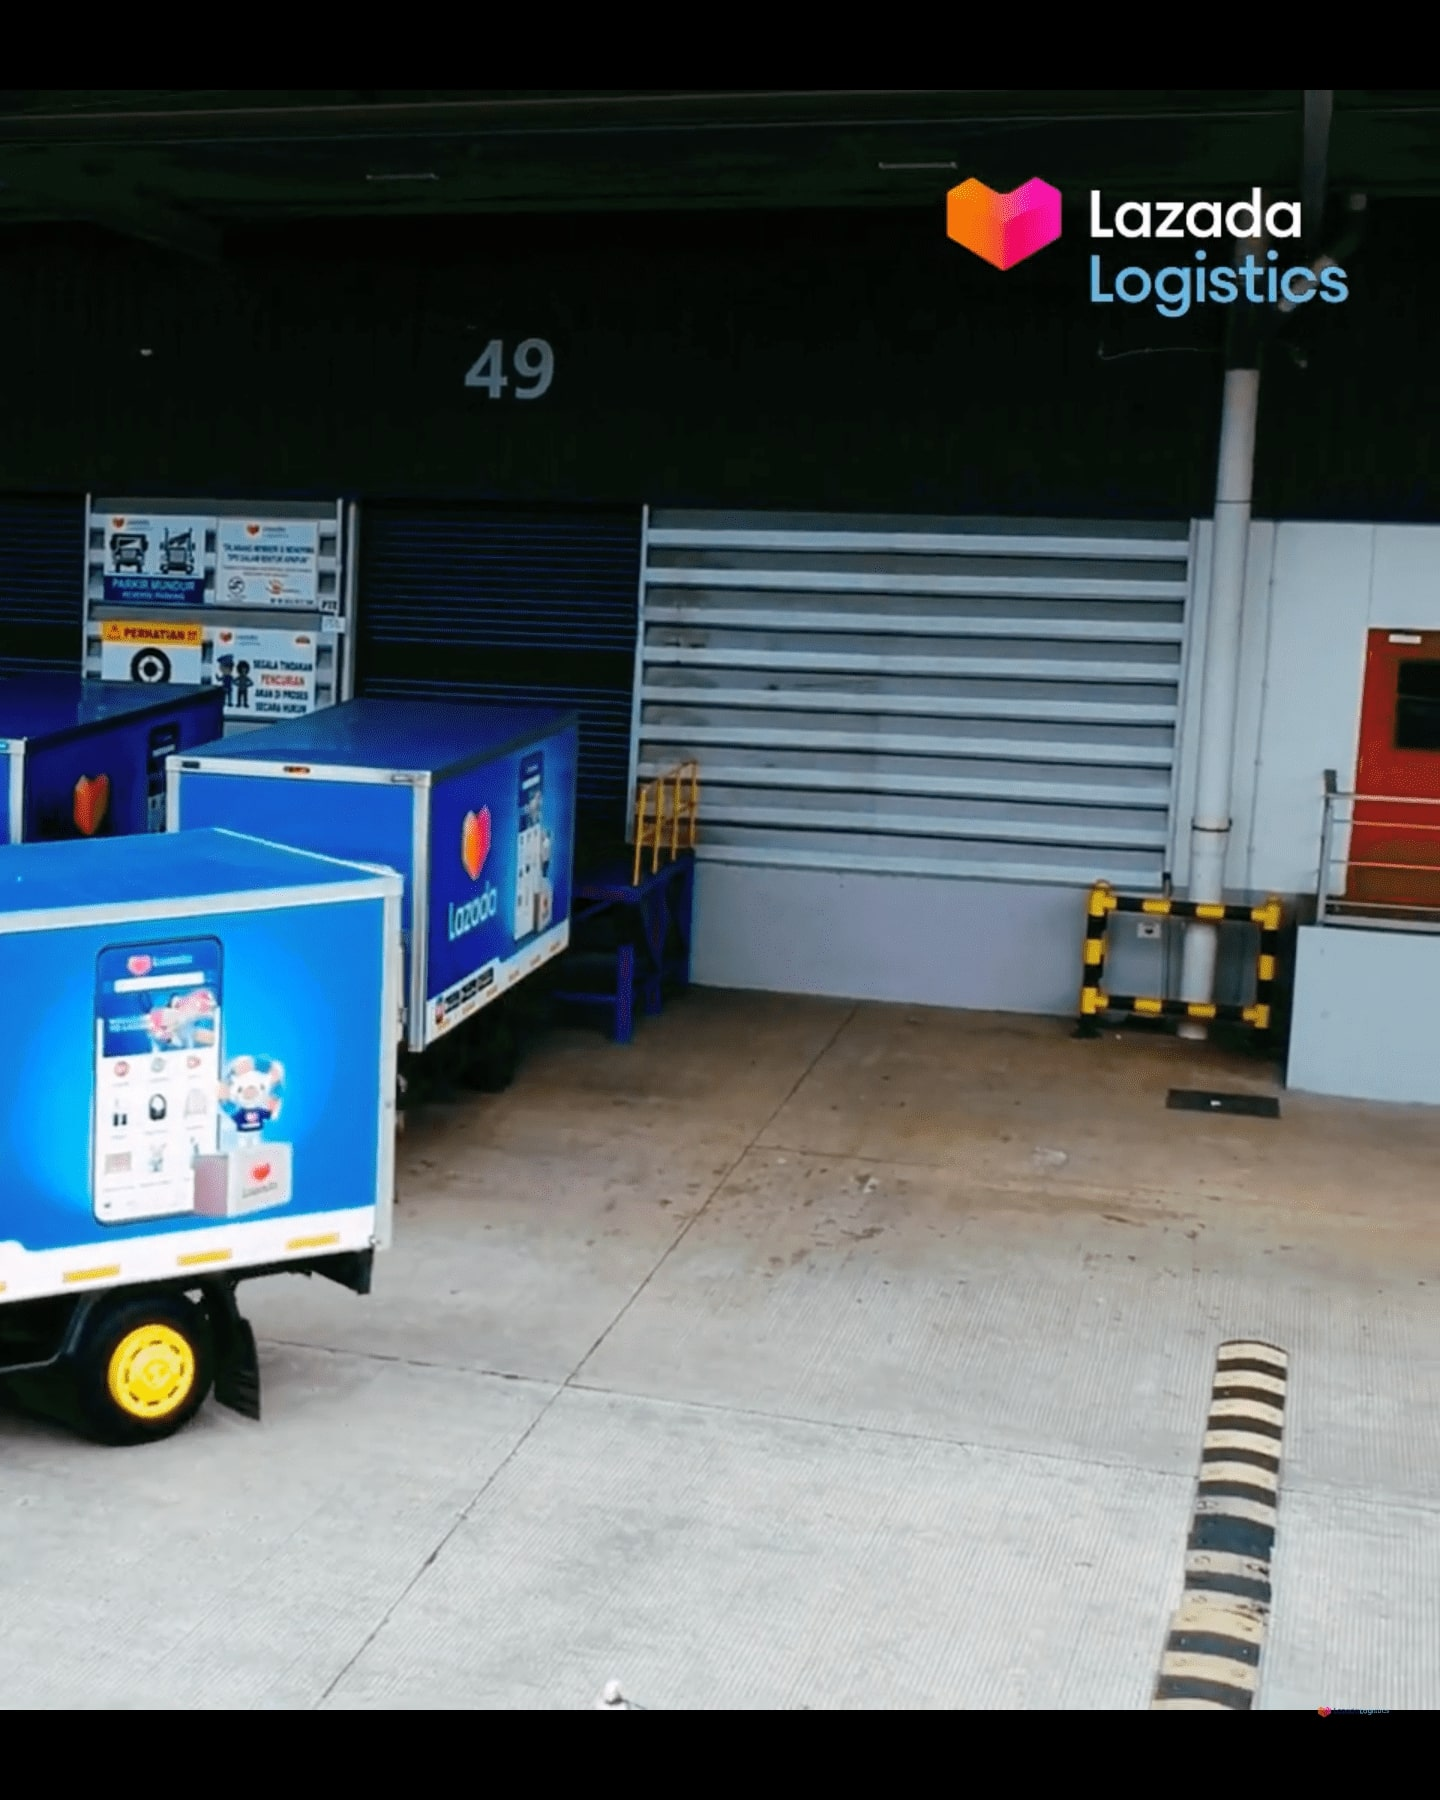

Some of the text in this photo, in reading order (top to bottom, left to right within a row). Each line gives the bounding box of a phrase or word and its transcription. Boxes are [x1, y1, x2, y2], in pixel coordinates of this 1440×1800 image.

[464, 338, 554, 400] 49
[123, 627, 186, 641] PERHATIAN
[448, 880, 498, 942] Lazada
